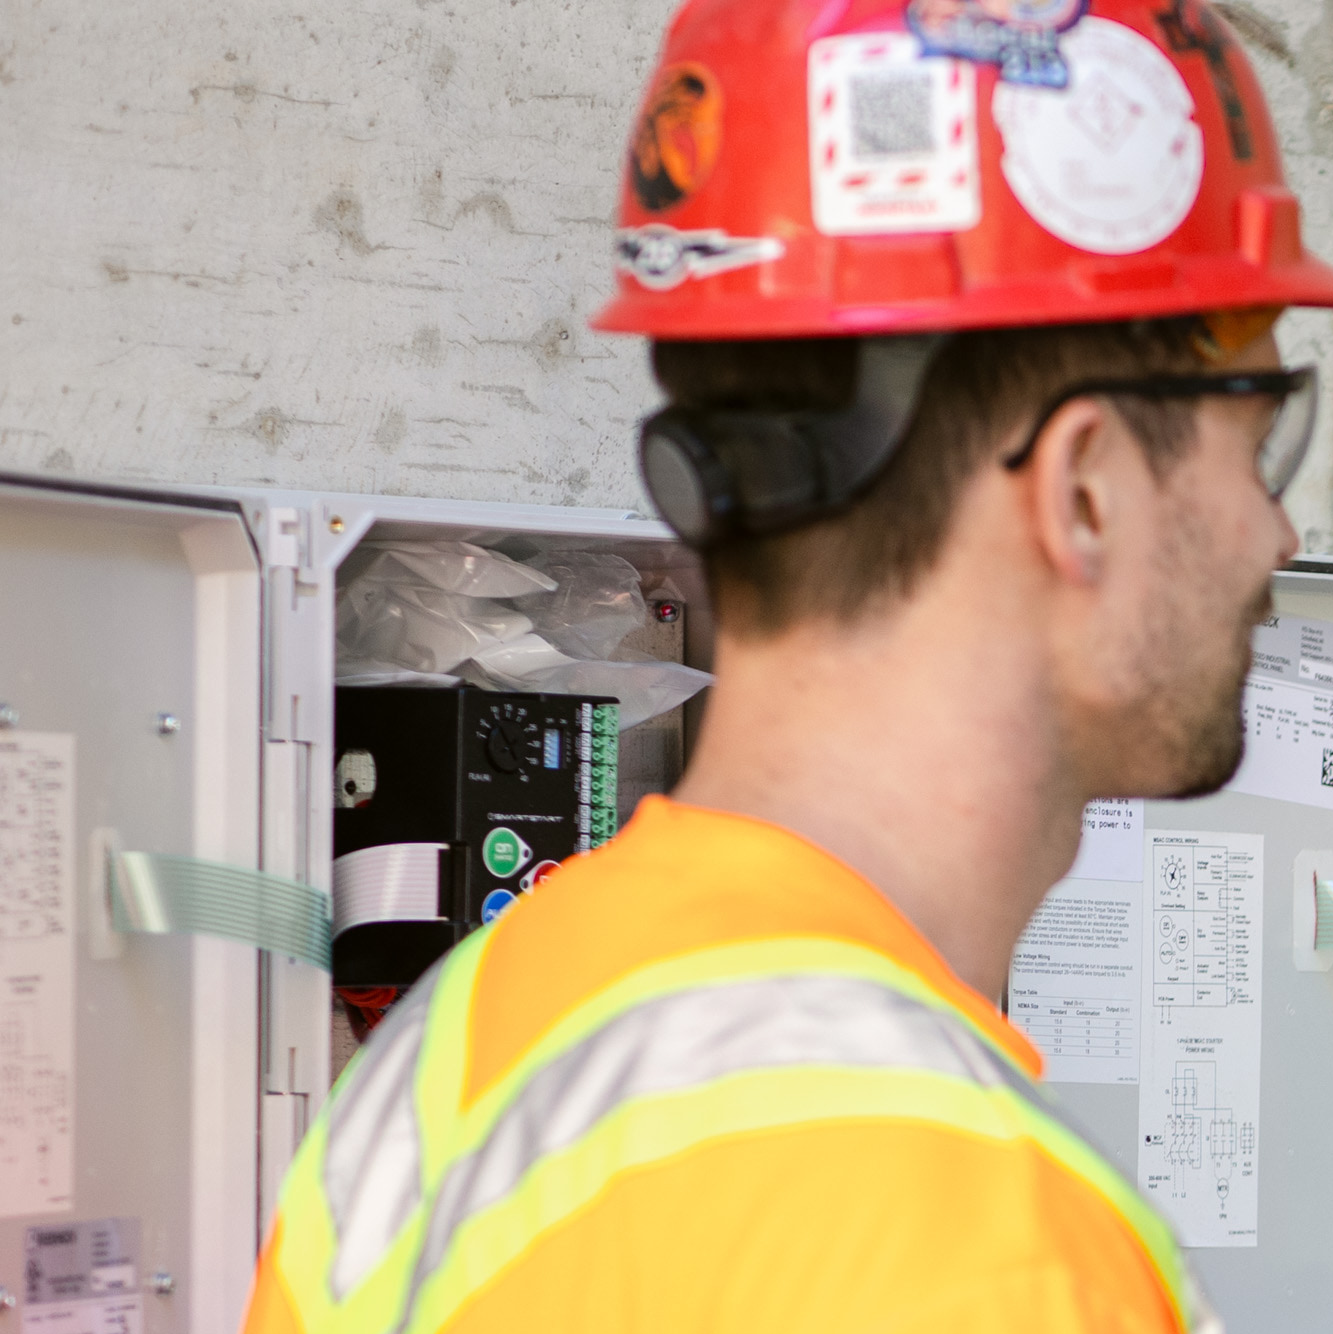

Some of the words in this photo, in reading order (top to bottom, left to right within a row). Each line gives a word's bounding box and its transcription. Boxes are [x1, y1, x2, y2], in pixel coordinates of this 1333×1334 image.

[1085, 807, 1121, 816] enclosure
[1126, 809, 1133, 817] is
[1084, 819, 1095, 829] ing
[1099, 821, 1118, 831] power
